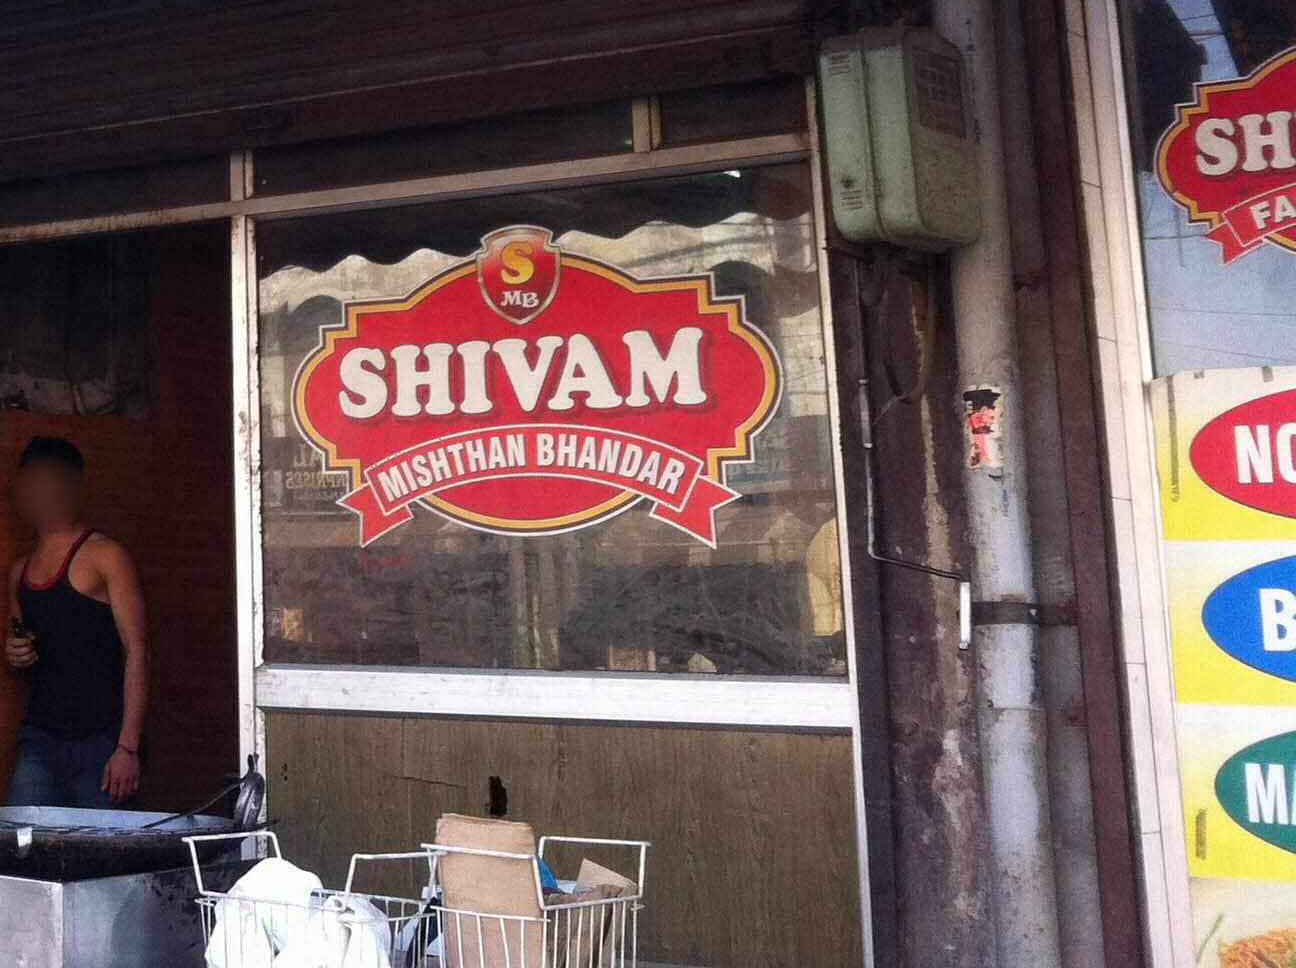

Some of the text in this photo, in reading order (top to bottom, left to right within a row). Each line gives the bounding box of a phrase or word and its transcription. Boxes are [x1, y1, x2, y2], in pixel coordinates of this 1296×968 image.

[501, 241, 534, 284] S
[500, 290, 539, 308] MB
[338, 327, 708, 418] SHIVAM
[378, 433, 687, 503] MISHTHAN BHANDAR
[1245, 763, 1296, 825] M
